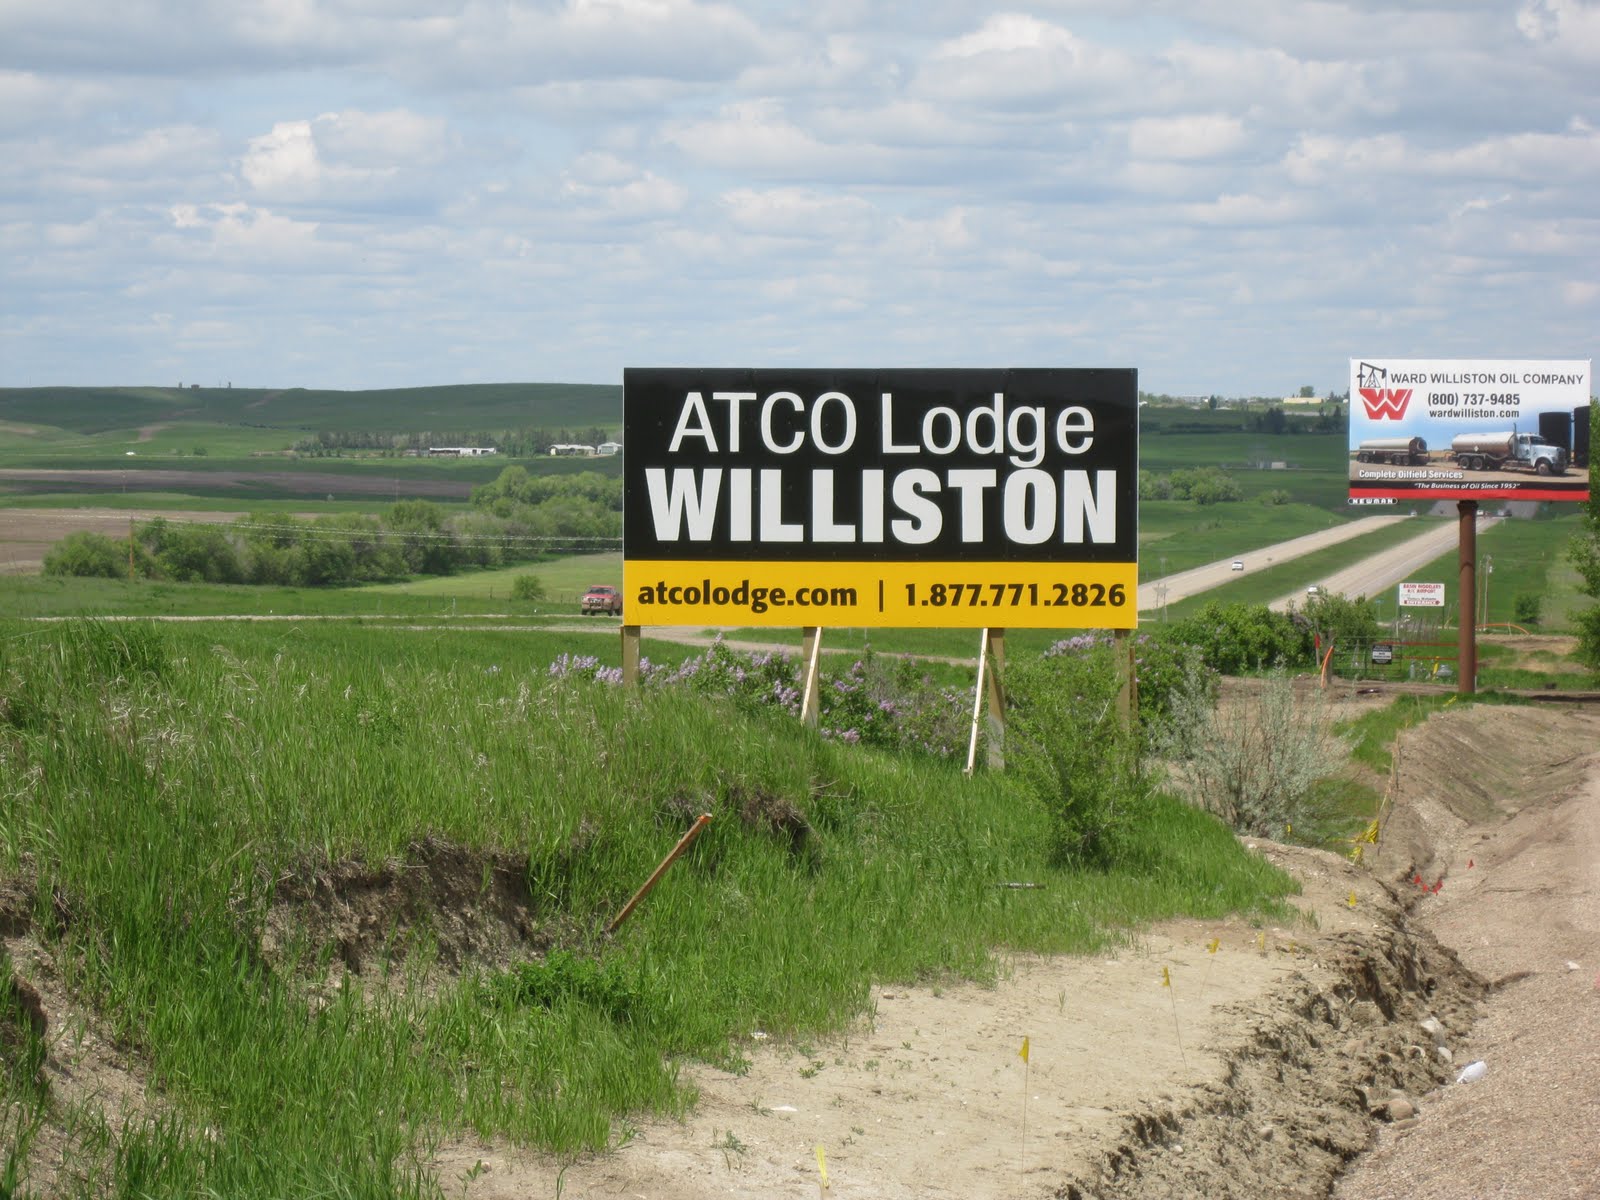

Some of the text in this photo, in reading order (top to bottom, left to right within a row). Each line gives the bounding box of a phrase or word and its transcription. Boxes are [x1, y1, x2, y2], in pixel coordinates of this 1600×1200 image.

[1391, 374, 1584, 385] WARD WILLISTON OIL COMPANY
[1427, 392, 1521, 406] (800) 737-9485
[1429, 408, 1520, 418] wardwilliston.com
[668, 391, 1095, 468] ATCO Lodge
[1359, 469, 1463, 480] Complete Oilfield Services
[645, 467, 1117, 545] WILLISTON
[1352, 497, 1394, 505] NEWMAN
[638, 579, 1126, 613] atcolodge.com 1.877.771.2826
